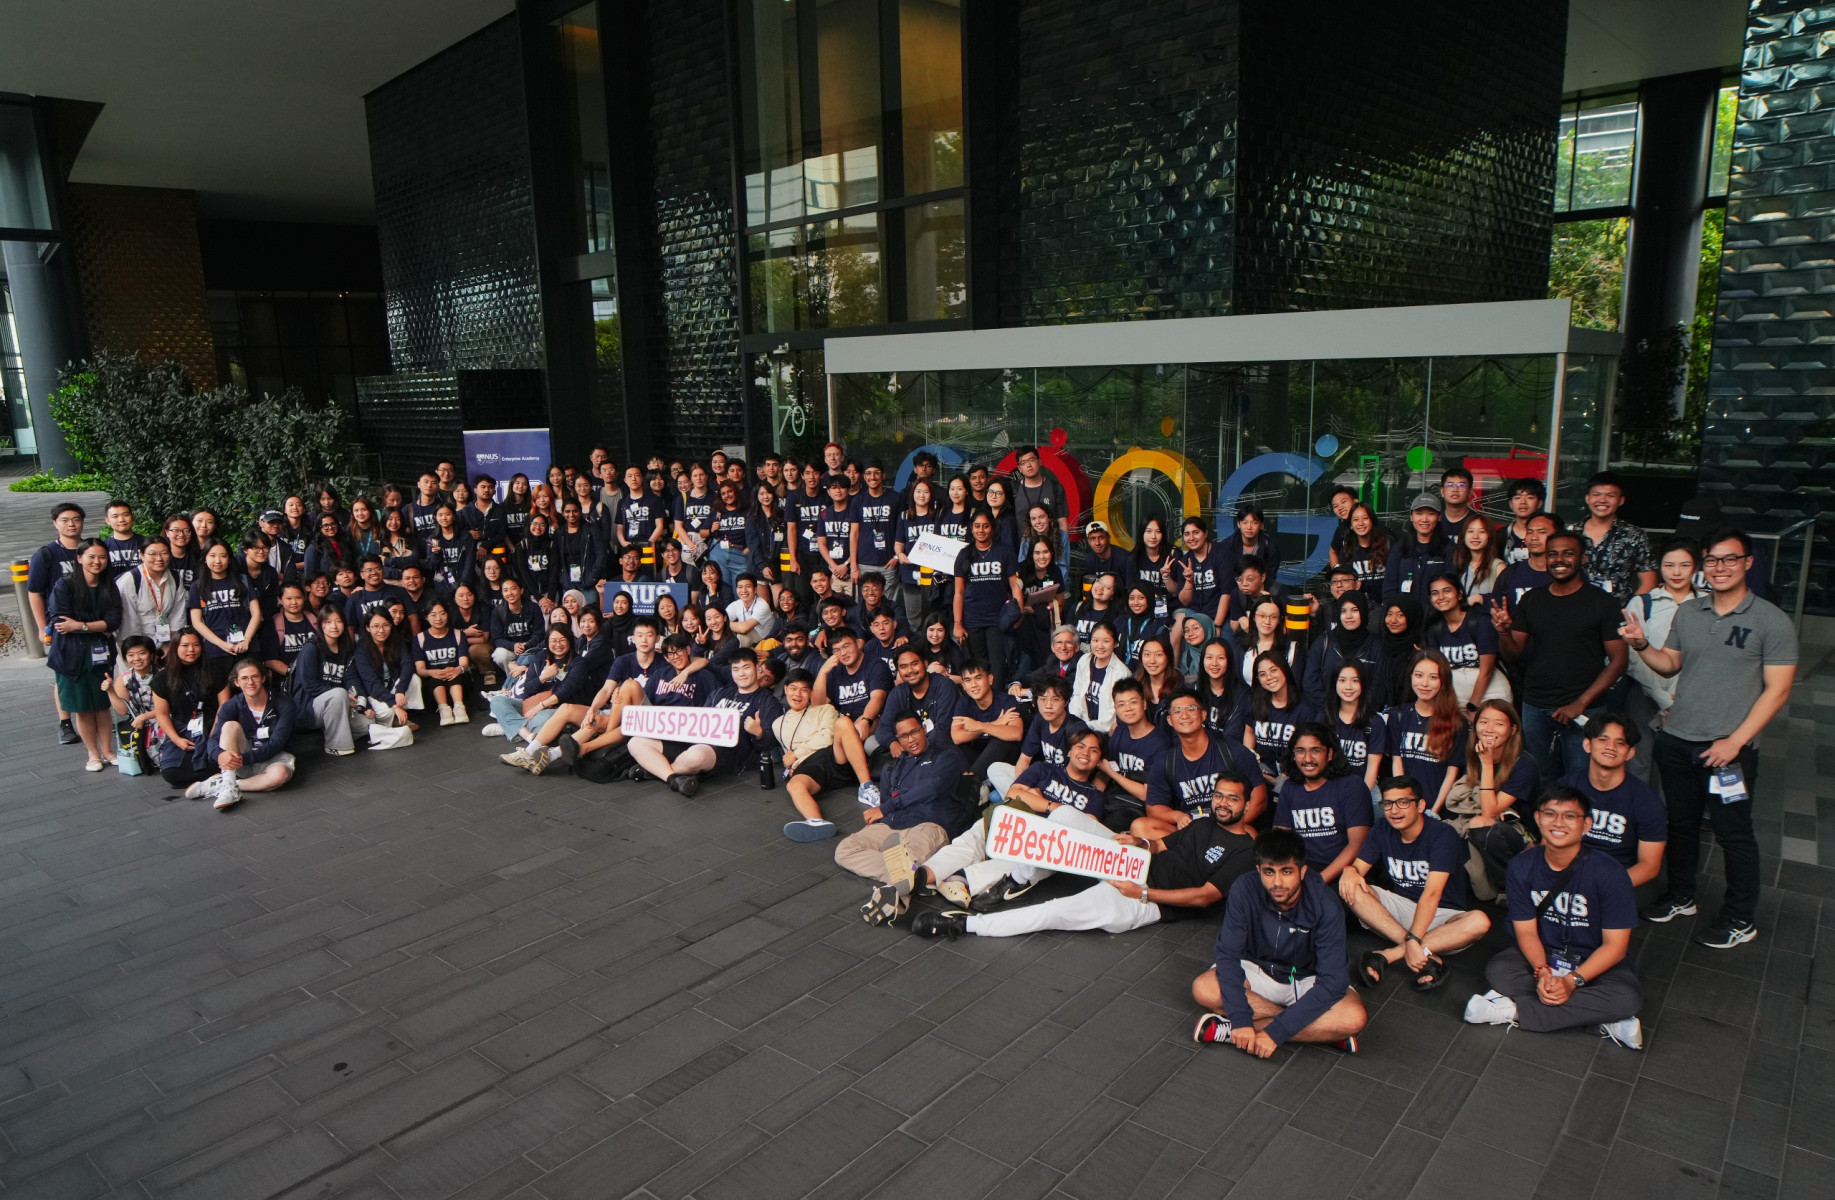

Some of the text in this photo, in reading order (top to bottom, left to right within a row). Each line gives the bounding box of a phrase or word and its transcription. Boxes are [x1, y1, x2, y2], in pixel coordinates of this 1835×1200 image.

[778, 405, 806, 437] 70
[626, 505, 649, 519] NUS
[686, 505, 711, 517] NUS
[863, 505, 891, 518] NUS
[414, 514, 438, 528] NU
[720, 516, 746, 528] NUS
[825, 521, 850, 534] NUS
[908, 523, 935, 537] NUS
[941, 523, 968, 537] NUS
[928, 543, 942, 553] NUS
[970, 561, 1002, 576] NUS
[1140, 569, 1169, 584] NU
[1193, 568, 1215, 584] US
[620, 584, 671, 605] NUS
[1076, 619, 1097, 635] NU
[1724, 625, 1752, 649] N
[425, 647, 457, 661] NUS
[1440, 643, 1480, 663] NUS
[322, 661, 346, 678] NUS
[839, 680, 867, 700] NUS
[625, 710, 735, 740] #NUSSP2024
[1255, 720, 1296, 742] NUS
[1401, 731, 1429, 752] NU
[1119, 752, 1145, 771] NUS
[1045, 780, 1089, 811] NUS
[1179, 773, 1219, 799] NUS
[1291, 806, 1336, 829] NUS
[1590, 808, 1627, 835] US
[993, 812, 1145, 880] #BestSummerEver
[1387, 856, 1430, 881] NUS
[1530, 889, 1589, 917] NUS
